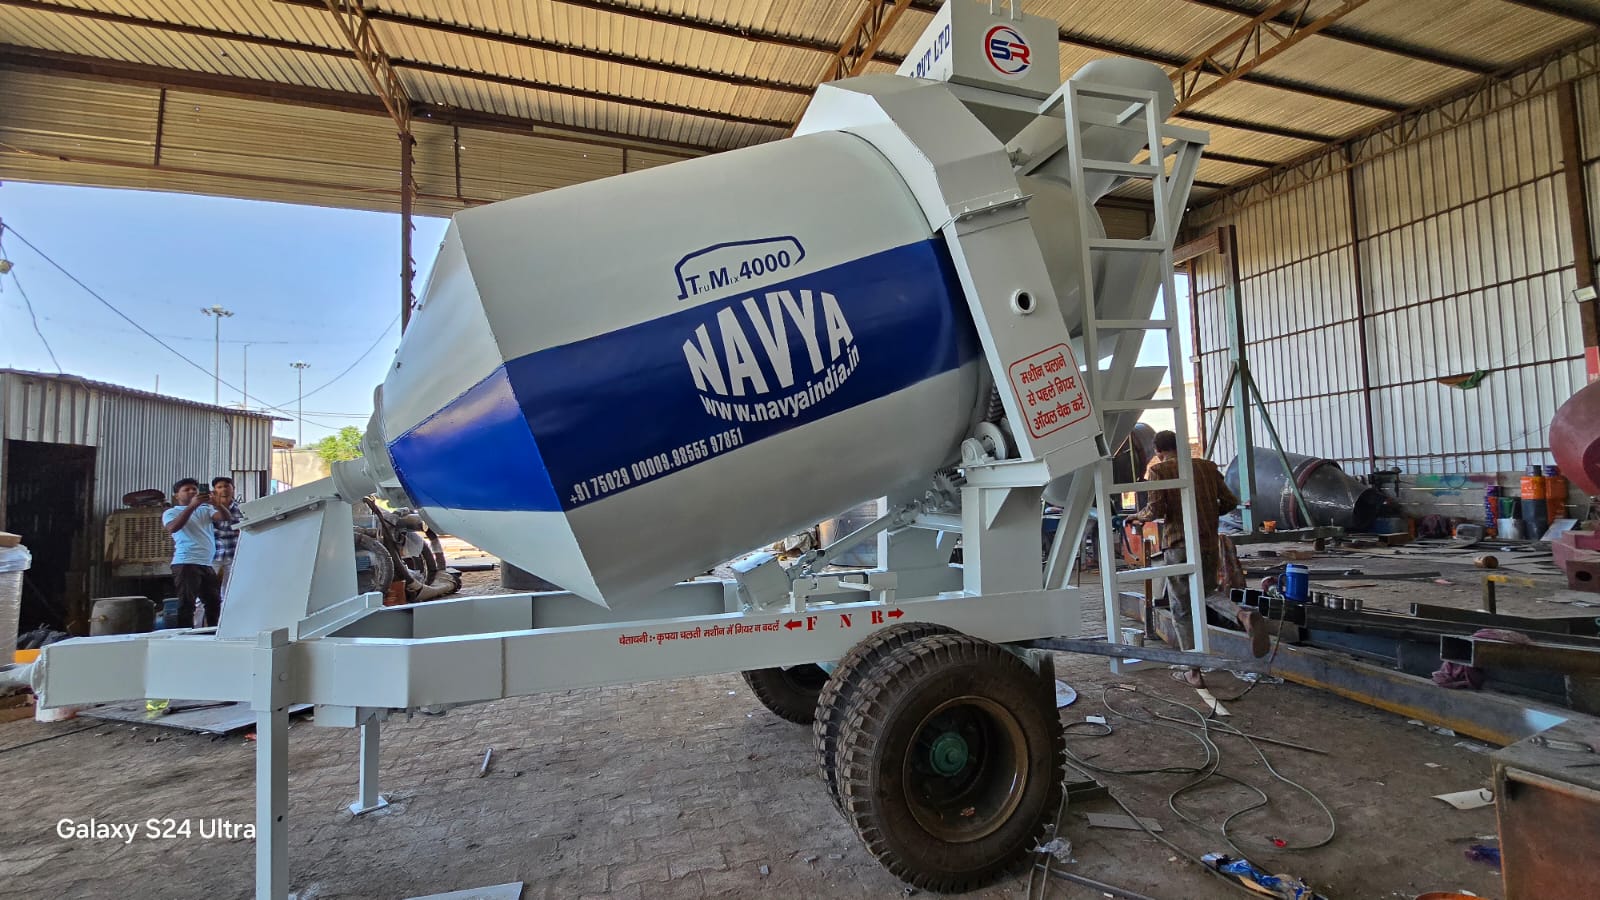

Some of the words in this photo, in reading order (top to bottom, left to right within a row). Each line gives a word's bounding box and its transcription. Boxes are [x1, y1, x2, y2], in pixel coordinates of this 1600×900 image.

[916, 48, 932, 78] PVT
[934, 24, 950, 62] LTD
[990, 38, 1031, 65] SR
[682, 289, 854, 396] NAVYA
[699, 344, 860, 422] www.navyaindia.in
[1020, 363, 1045, 384] मशीन
[1044, 352, 1067, 373] चलाने
[1026, 389, 1037, 406] से
[1035, 381, 1056, 402] पहले
[1055, 376, 1077, 395] गियर
[1033, 410, 1058, 430] ऑयल
[1071, 391, 1086, 412] करें
[570, 480, 592, 504] +91
[590, 467, 630, 496] 75029
[709, 426, 744, 453] 97851
[656, 631, 679, 646] कृपया
[680, 626, 702, 640] चलती
[704, 624, 725, 637] मशीन
[727, 623, 735, 636] में
[735, 622, 754, 635] गियर
[754, 624, 762, 633] न
[806, 616, 818, 631] F
[840, 613, 853, 628] N
[871, 610, 884, 625] R
